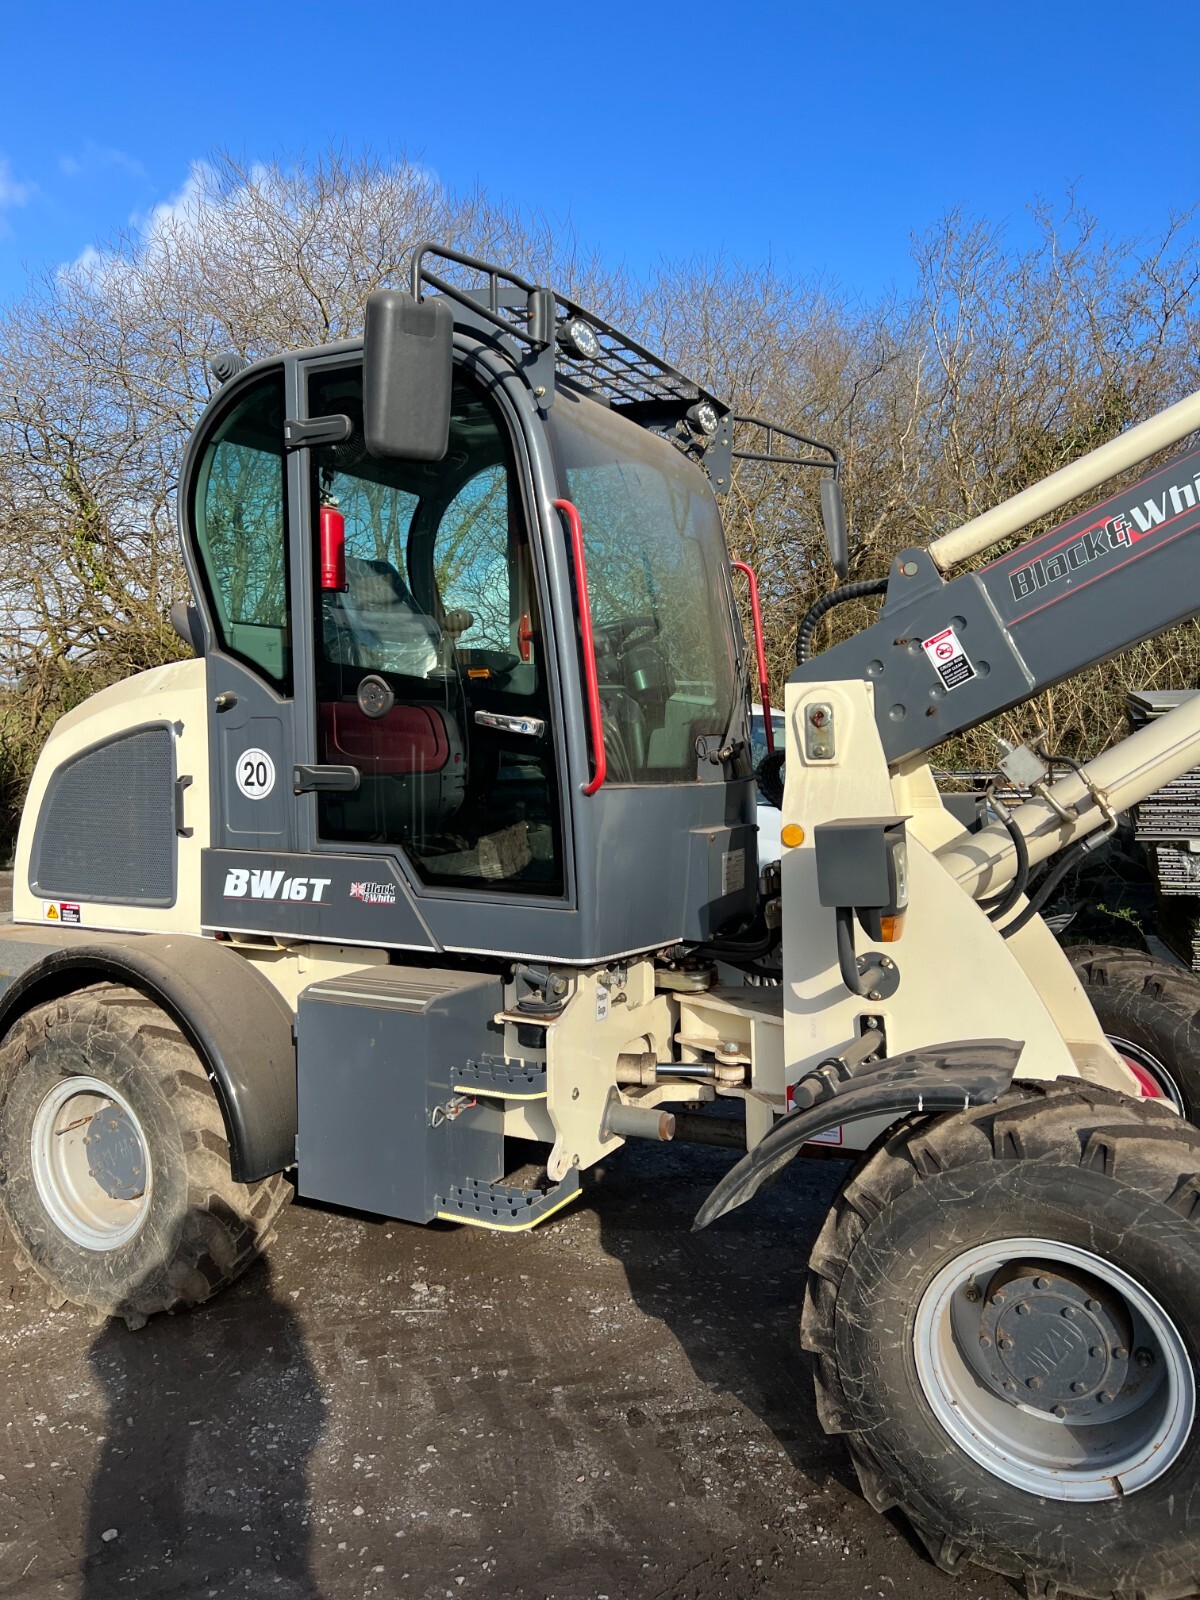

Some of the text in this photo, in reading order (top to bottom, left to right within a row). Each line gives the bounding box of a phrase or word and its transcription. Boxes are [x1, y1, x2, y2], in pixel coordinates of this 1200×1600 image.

[244, 761, 267, 787] 20
[364, 881, 396, 895] Black
[369, 893, 396, 903] White
